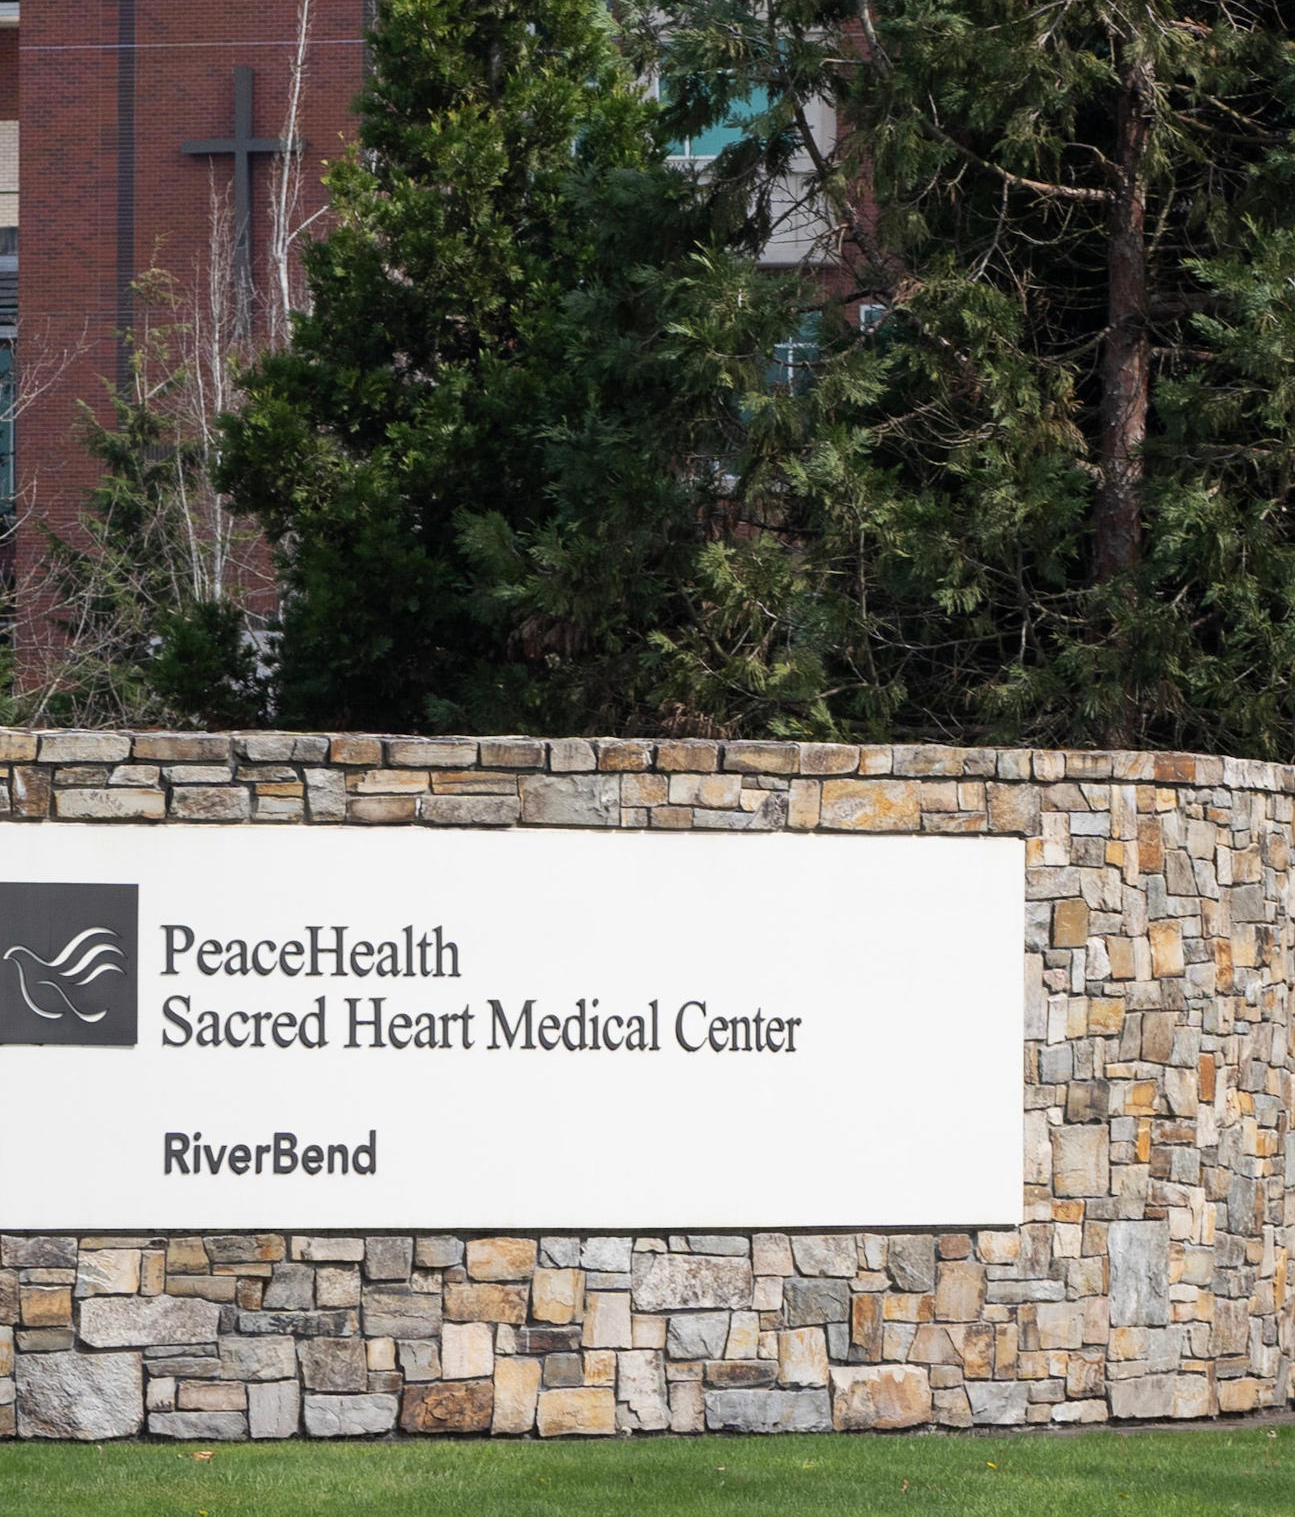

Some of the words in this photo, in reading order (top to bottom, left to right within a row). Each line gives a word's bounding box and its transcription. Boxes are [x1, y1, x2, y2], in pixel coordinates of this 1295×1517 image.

[160, 924, 461, 978] PeaceHealth
[162, 994, 329, 1050] Sacred
[343, 997, 475, 1050] Heart
[486, 998, 661, 1052] Medical
[675, 1000, 802, 1053] Center
[164, 1129, 377, 1176] RiverBend
